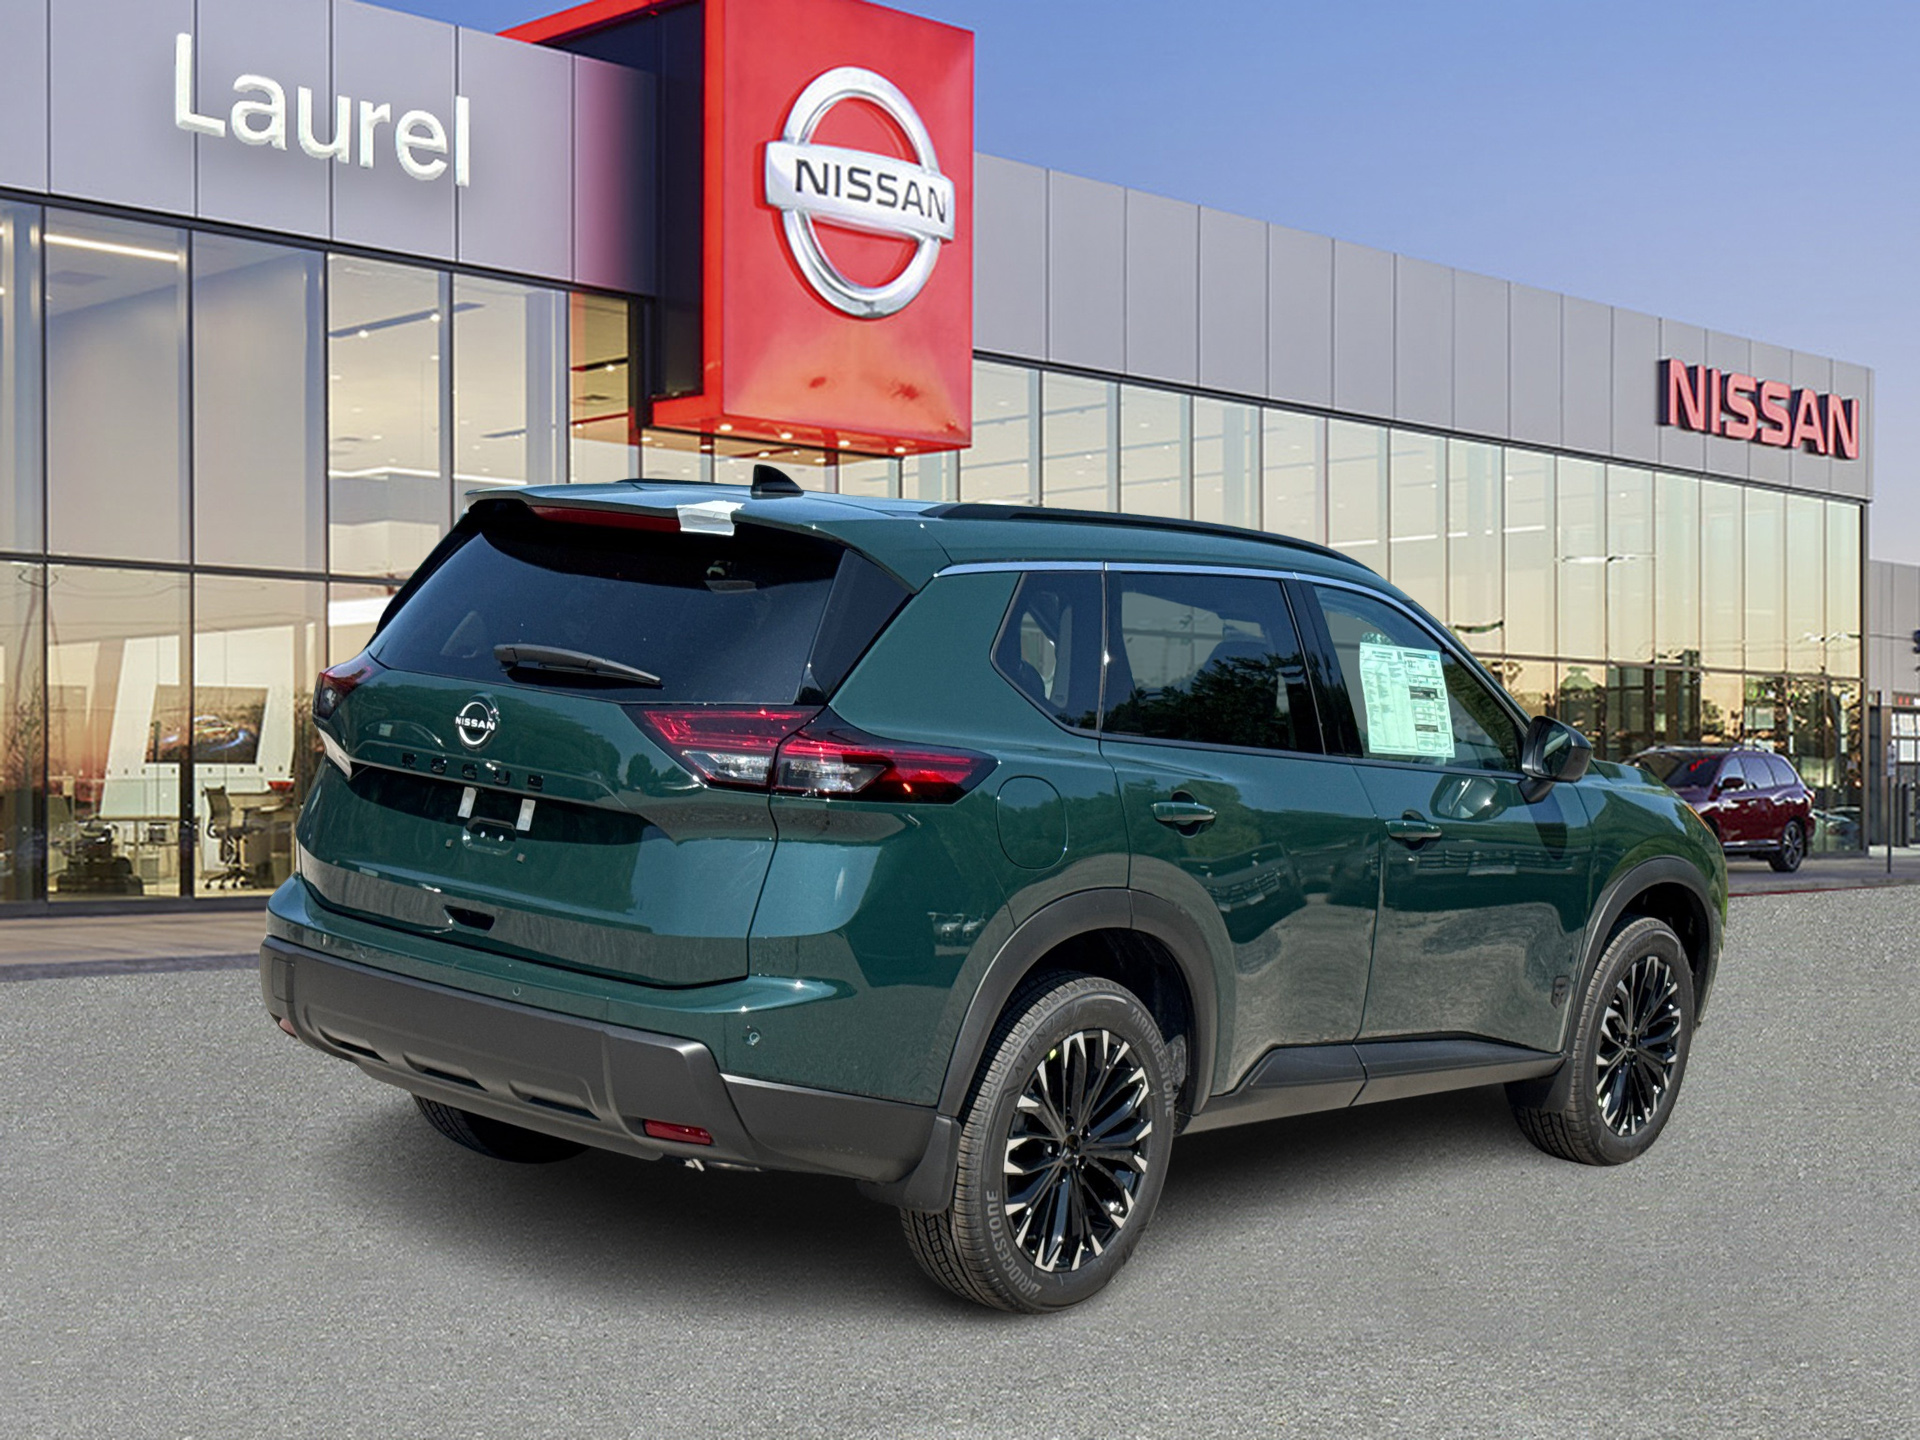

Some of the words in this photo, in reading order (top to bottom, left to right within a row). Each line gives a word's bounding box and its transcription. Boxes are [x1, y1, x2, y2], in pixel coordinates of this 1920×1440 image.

[175, 32, 470, 188] Laurel
[795, 158, 946, 223] NISSAN
[1656, 357, 1860, 460] NISSAN
[401, 752, 544, 791] ROGUE
[455, 716, 496, 731] NISSAN
[1131, 1006, 1174, 1118] BRIDGESTONE
[986, 1190, 1043, 1300] BRIDGESTONE
